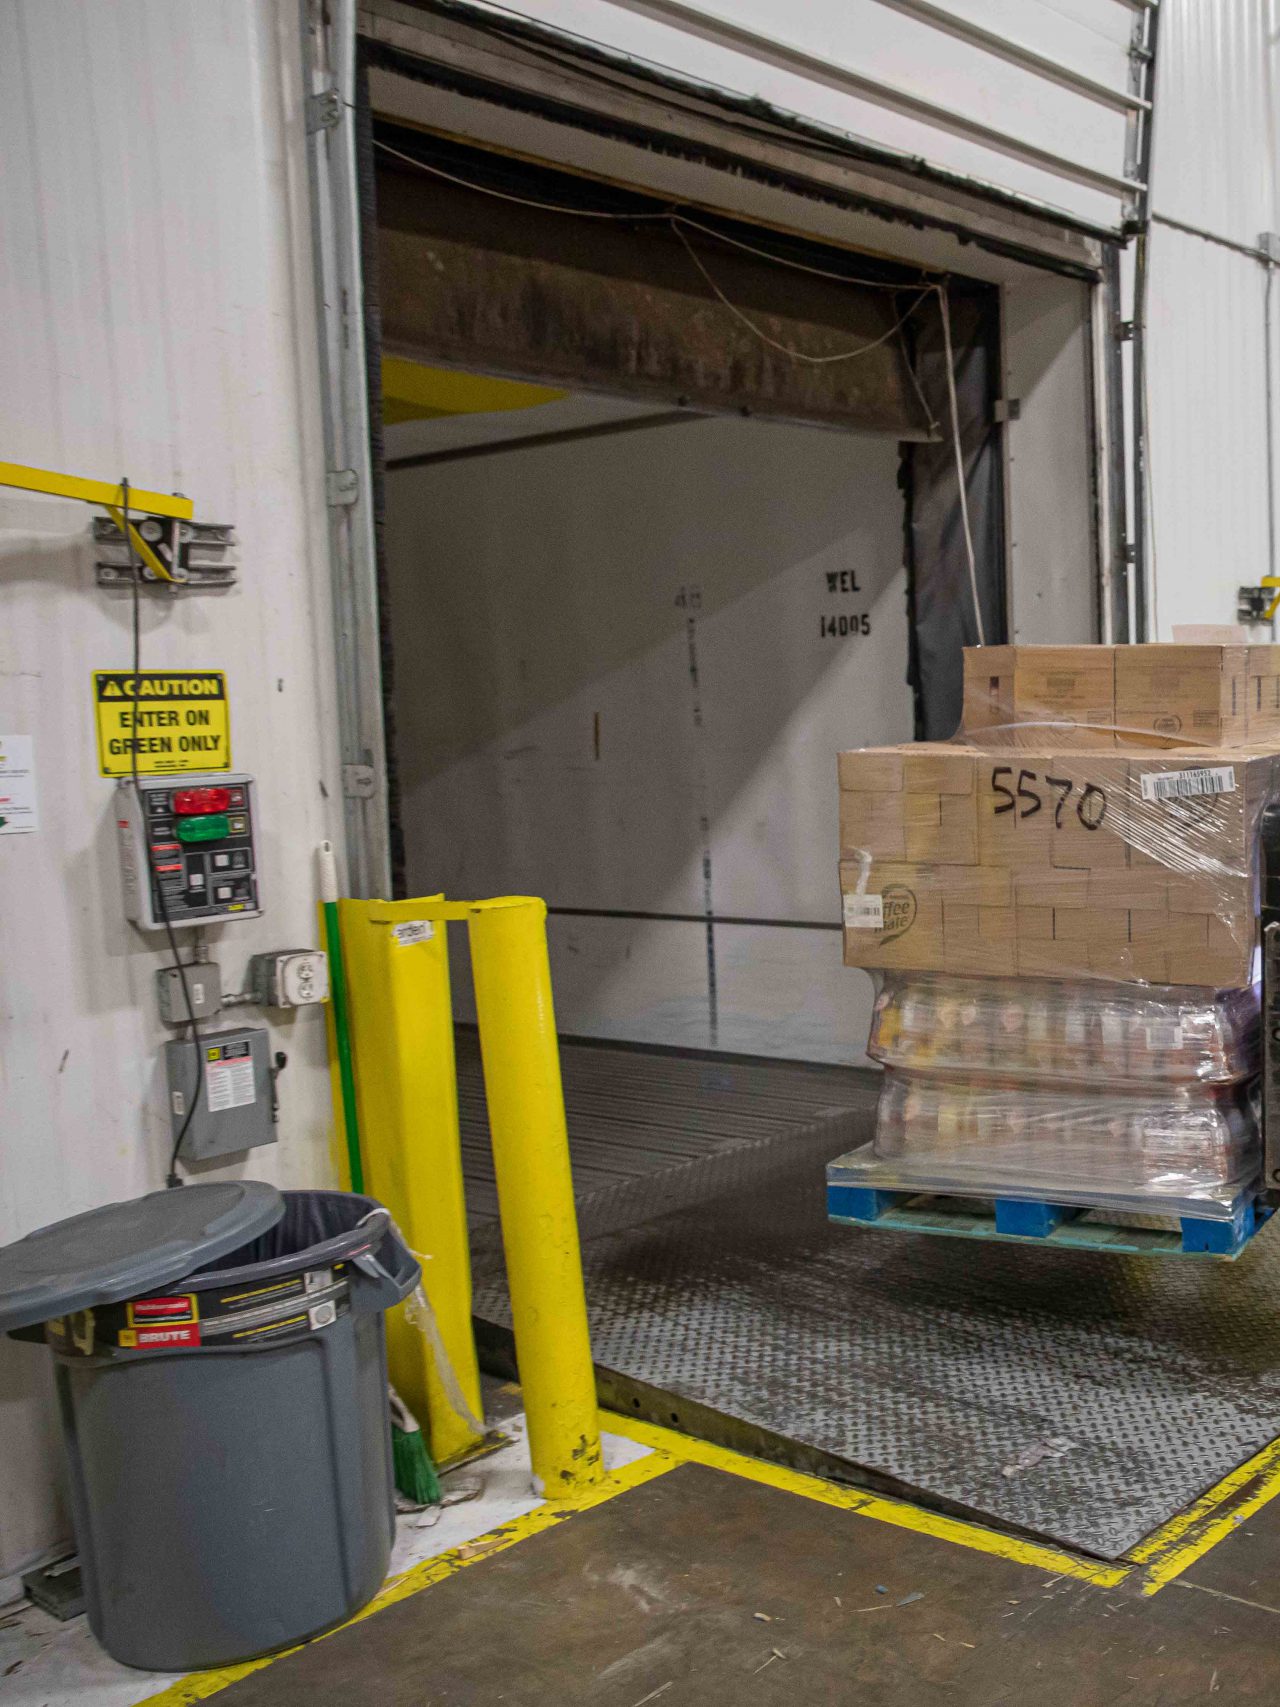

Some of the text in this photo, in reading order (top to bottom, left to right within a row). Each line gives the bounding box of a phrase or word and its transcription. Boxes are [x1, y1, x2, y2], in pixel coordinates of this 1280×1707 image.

[826, 570, 860, 592] WEL
[820, 614, 870, 638] 14005
[123, 679, 219, 696] CAUTION
[119, 710, 210, 728] ENTER ON
[109, 735, 221, 755] GREEN ONLY
[991, 767, 1107, 831] 5570
[139, 1330, 191, 1343] BRUTE
